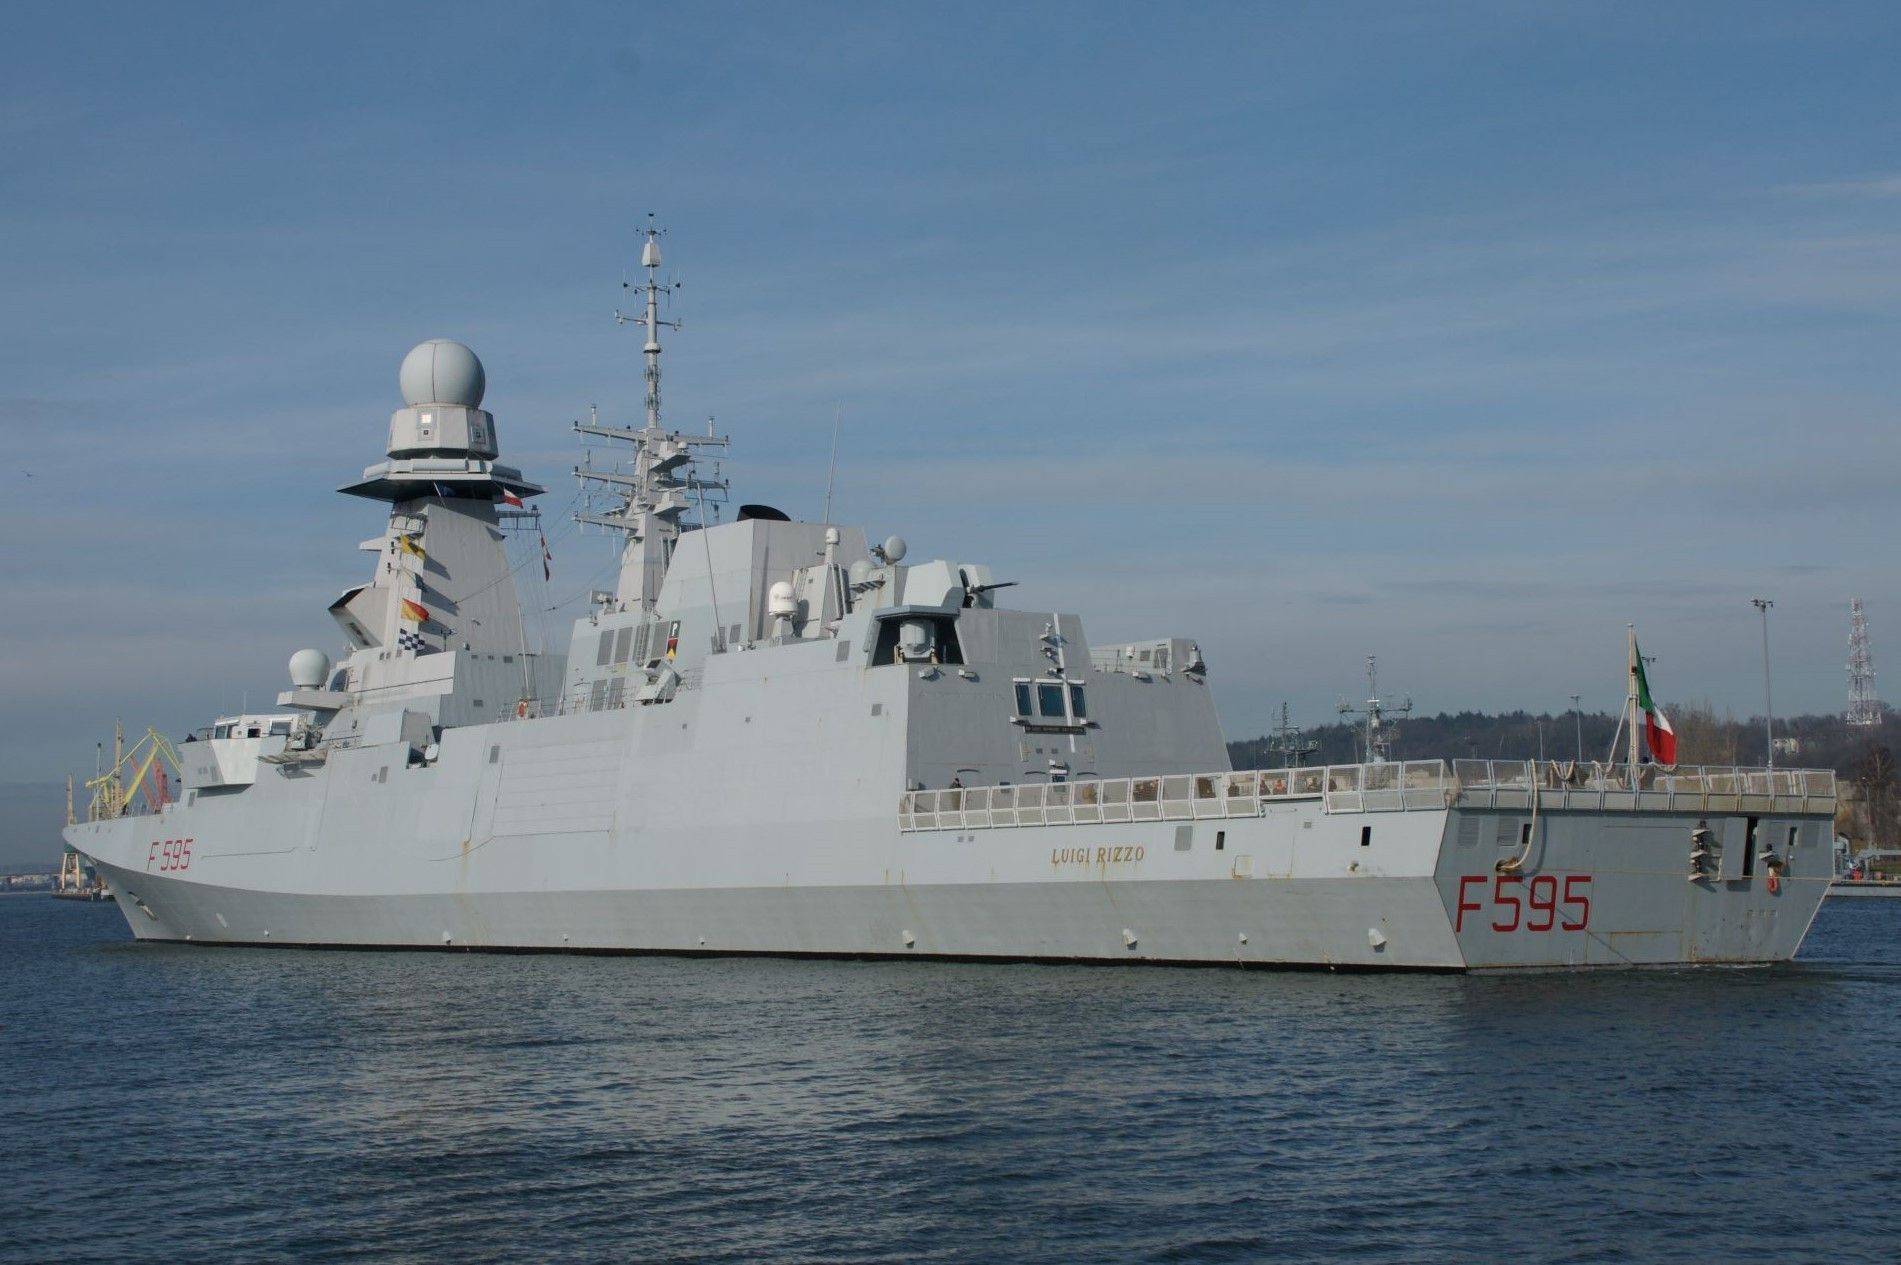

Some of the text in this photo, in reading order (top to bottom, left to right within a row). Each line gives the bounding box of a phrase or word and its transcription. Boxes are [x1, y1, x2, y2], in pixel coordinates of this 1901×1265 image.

[1051, 846, 1145, 864] LUIGI RIZZO
[1456, 875, 1592, 933] F595
